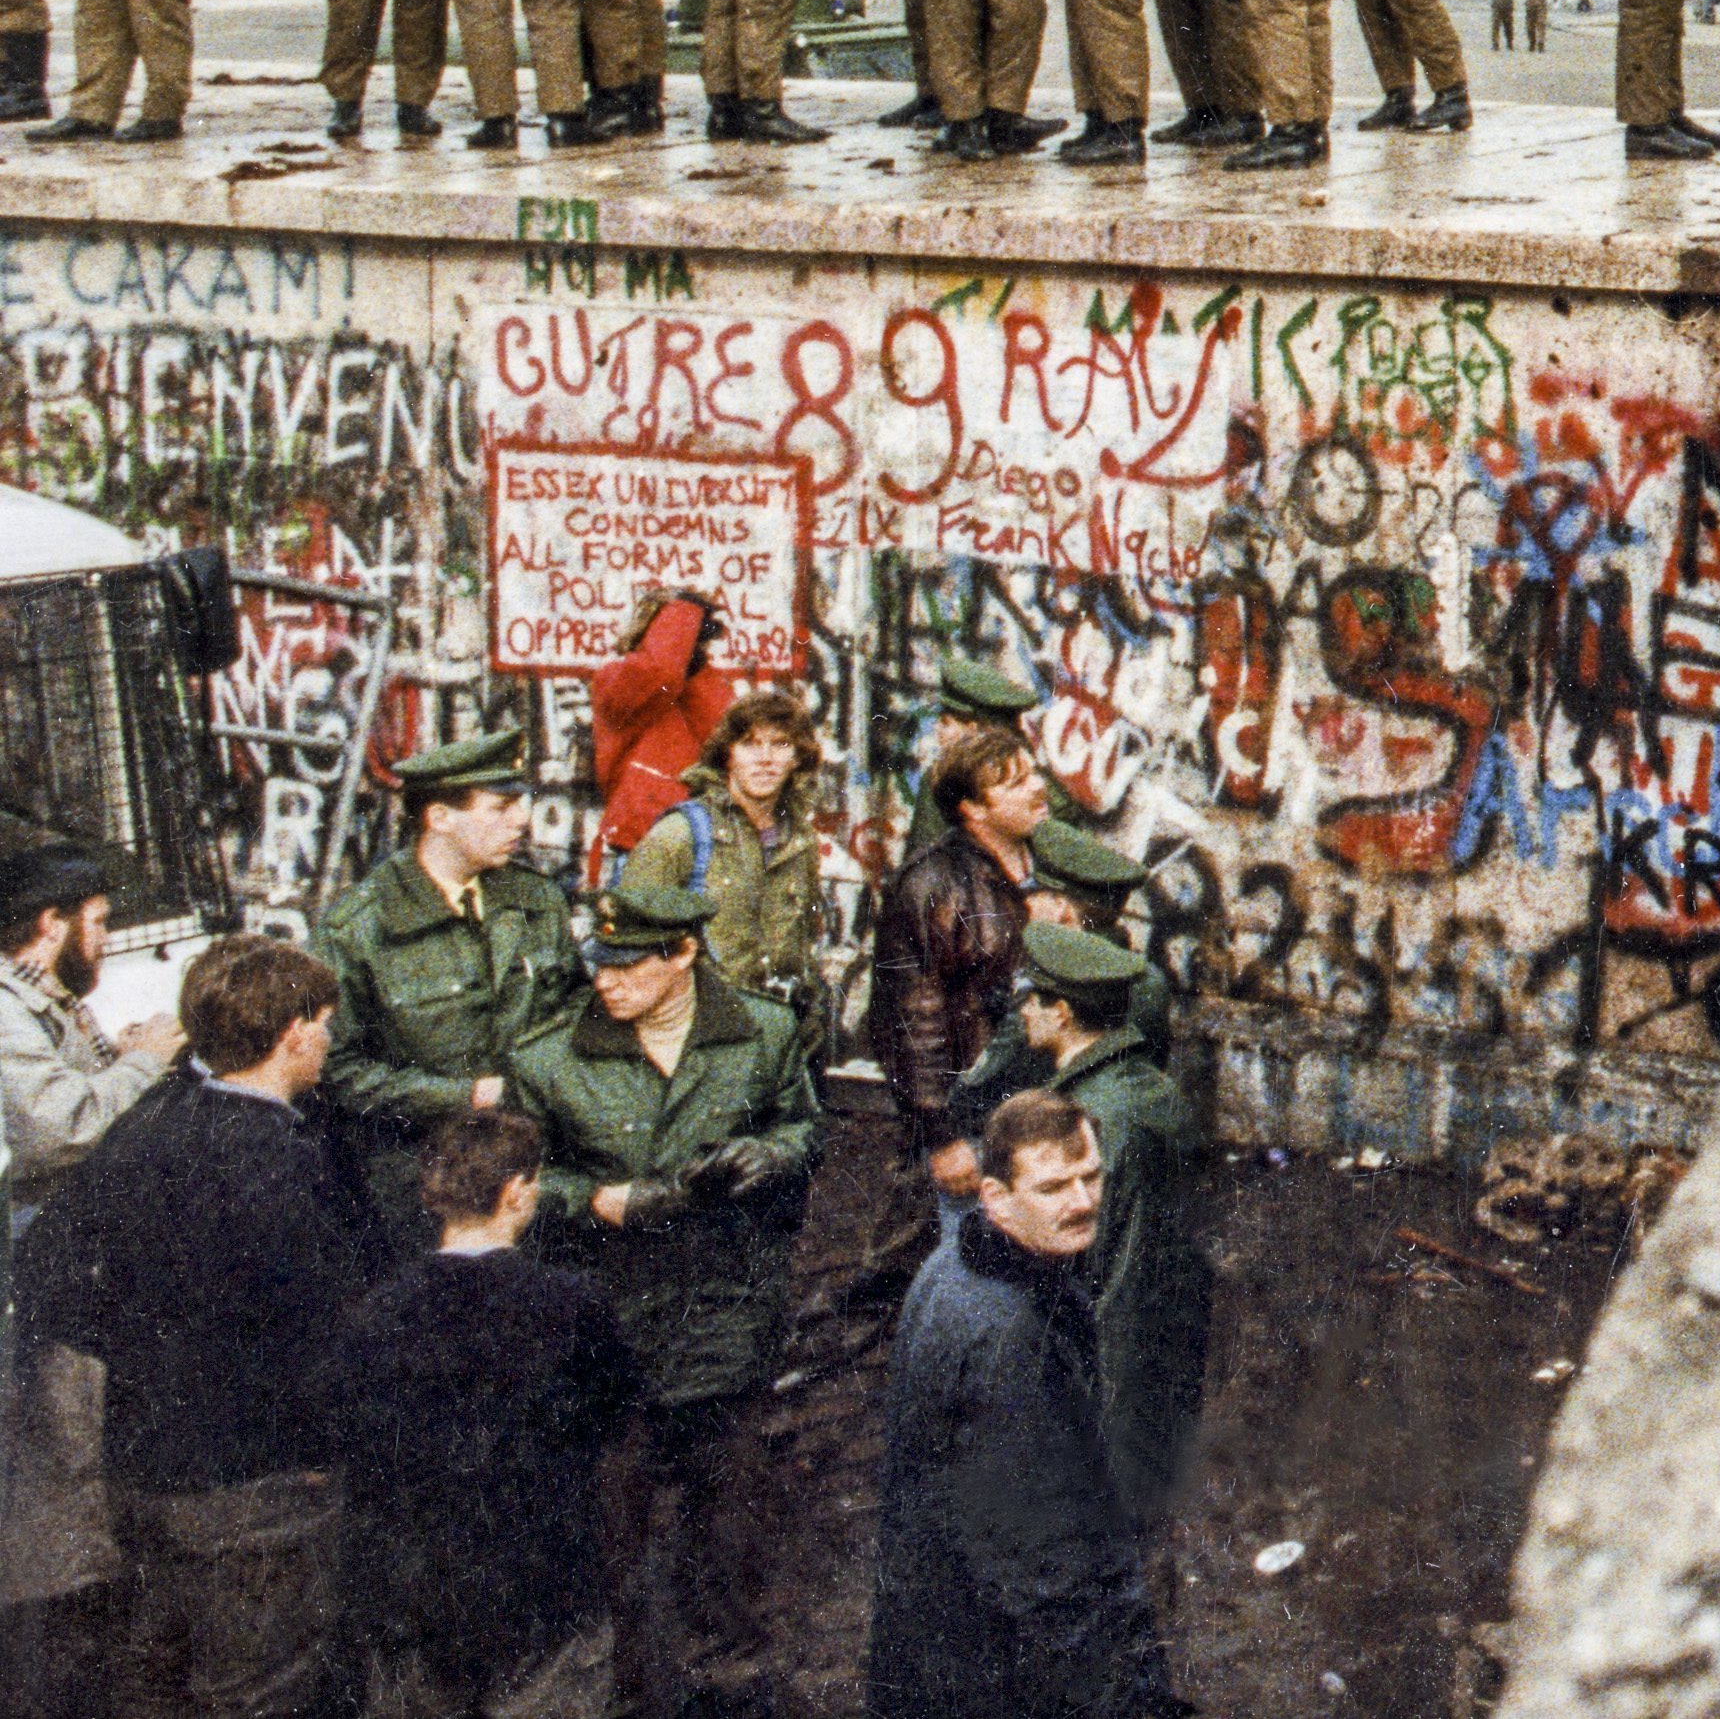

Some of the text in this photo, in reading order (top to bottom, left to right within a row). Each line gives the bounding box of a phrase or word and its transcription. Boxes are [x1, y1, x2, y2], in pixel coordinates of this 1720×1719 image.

[506, 465, 606, 505] ESSEX
[563, 506, 751, 546] CONDEMNS
[500, 532, 773, 585] ALL FORMS OF
